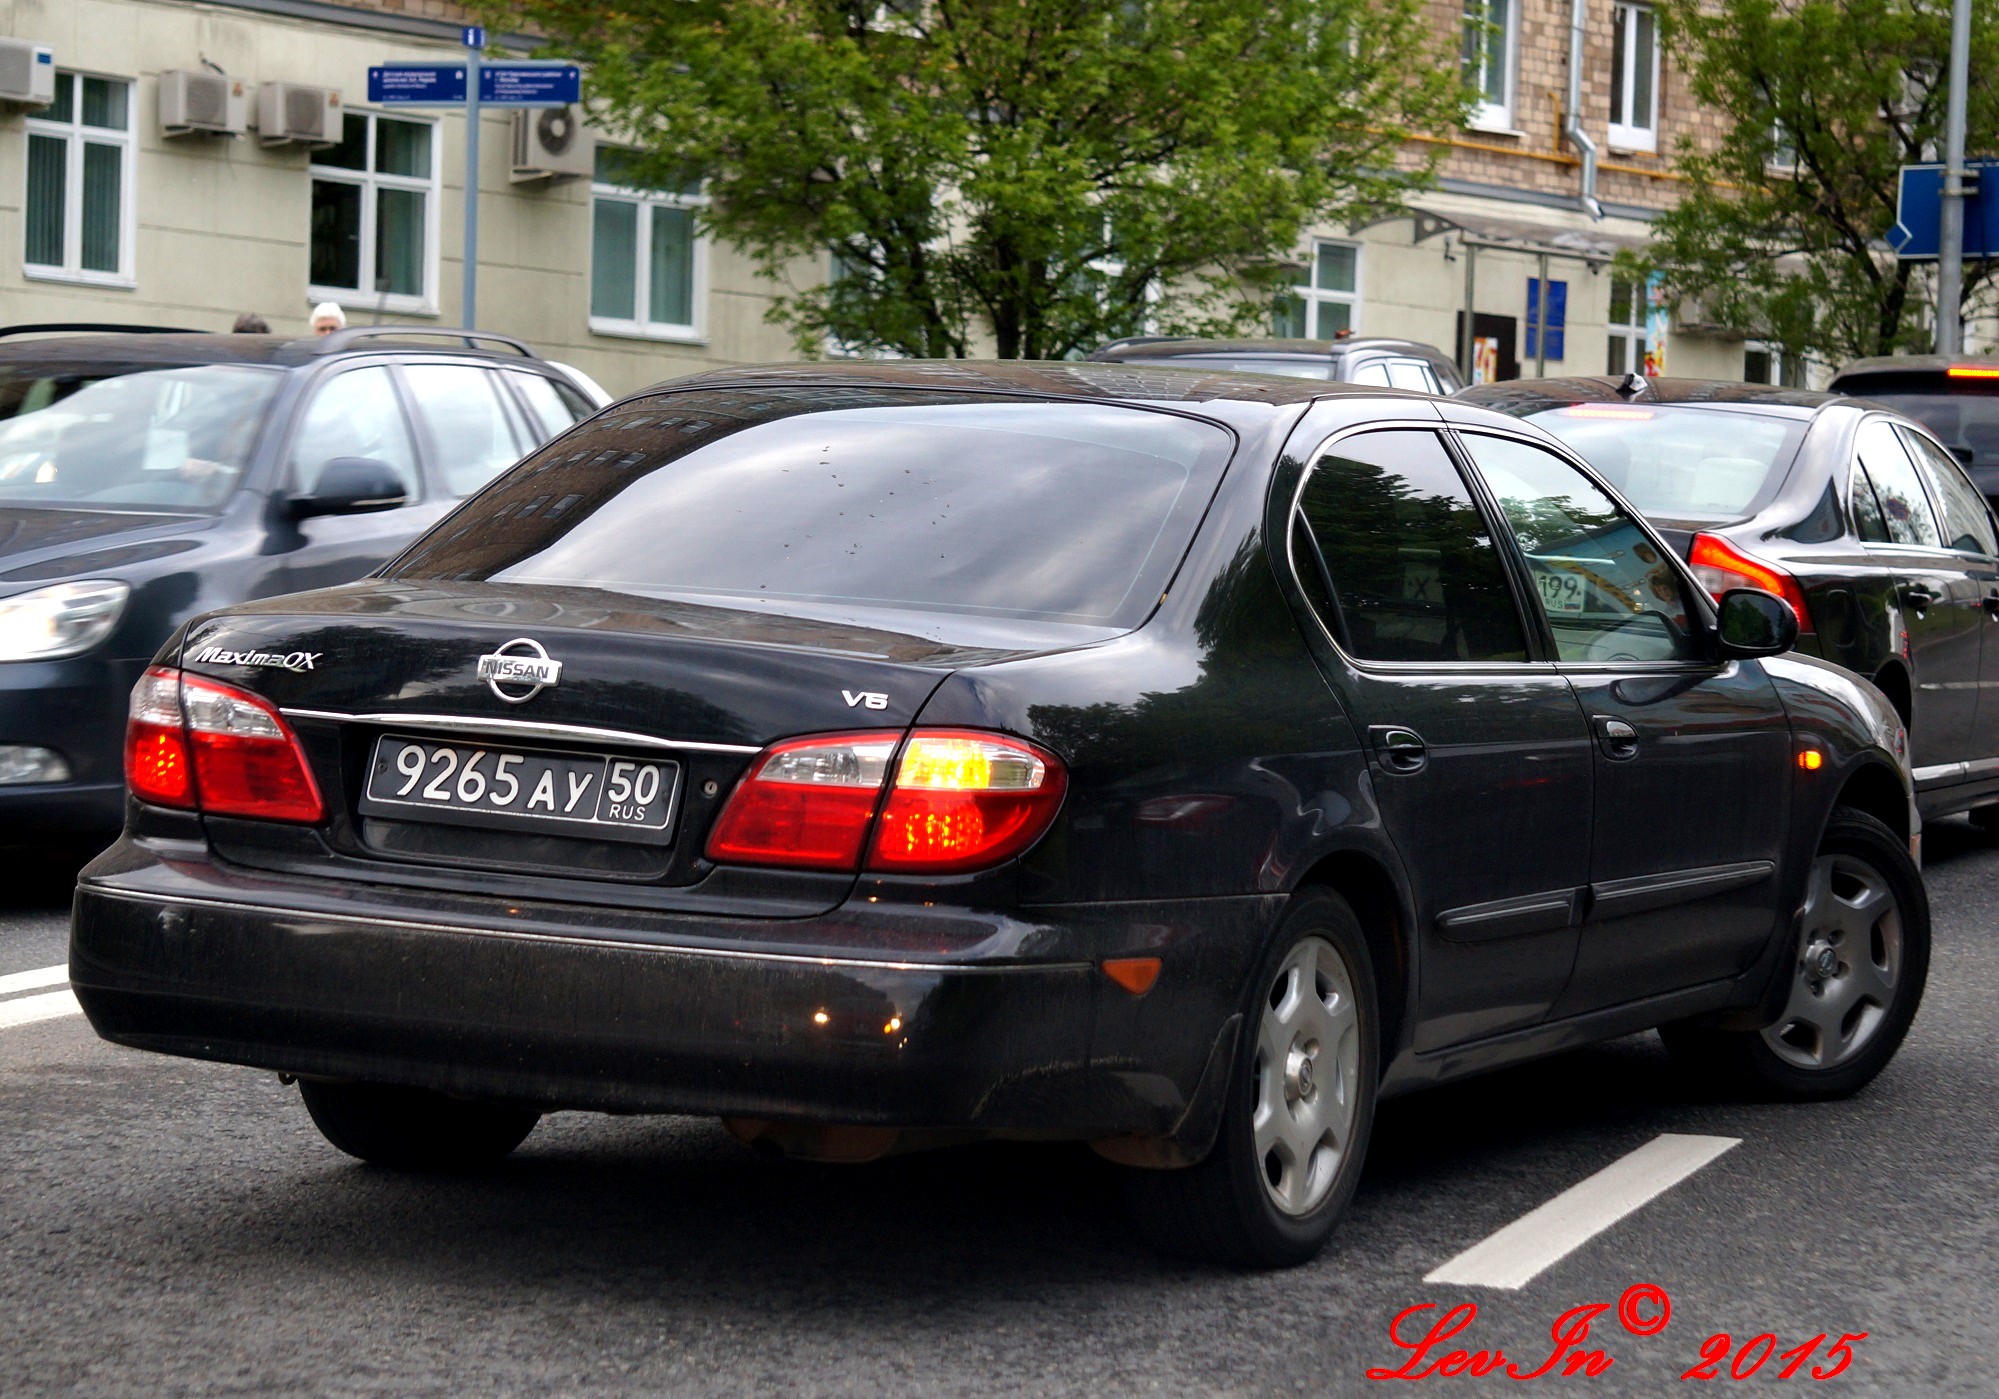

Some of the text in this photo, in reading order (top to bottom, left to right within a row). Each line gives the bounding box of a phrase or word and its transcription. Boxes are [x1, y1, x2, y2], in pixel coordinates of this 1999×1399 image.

[1539, 574, 1578, 600] 199
[484, 660, 550, 680] NISSAN
[841, 689, 889, 710] V6
[396, 744, 525, 806] 9265
[607, 761, 661, 806] 50
[608, 804, 646, 822] RUS
